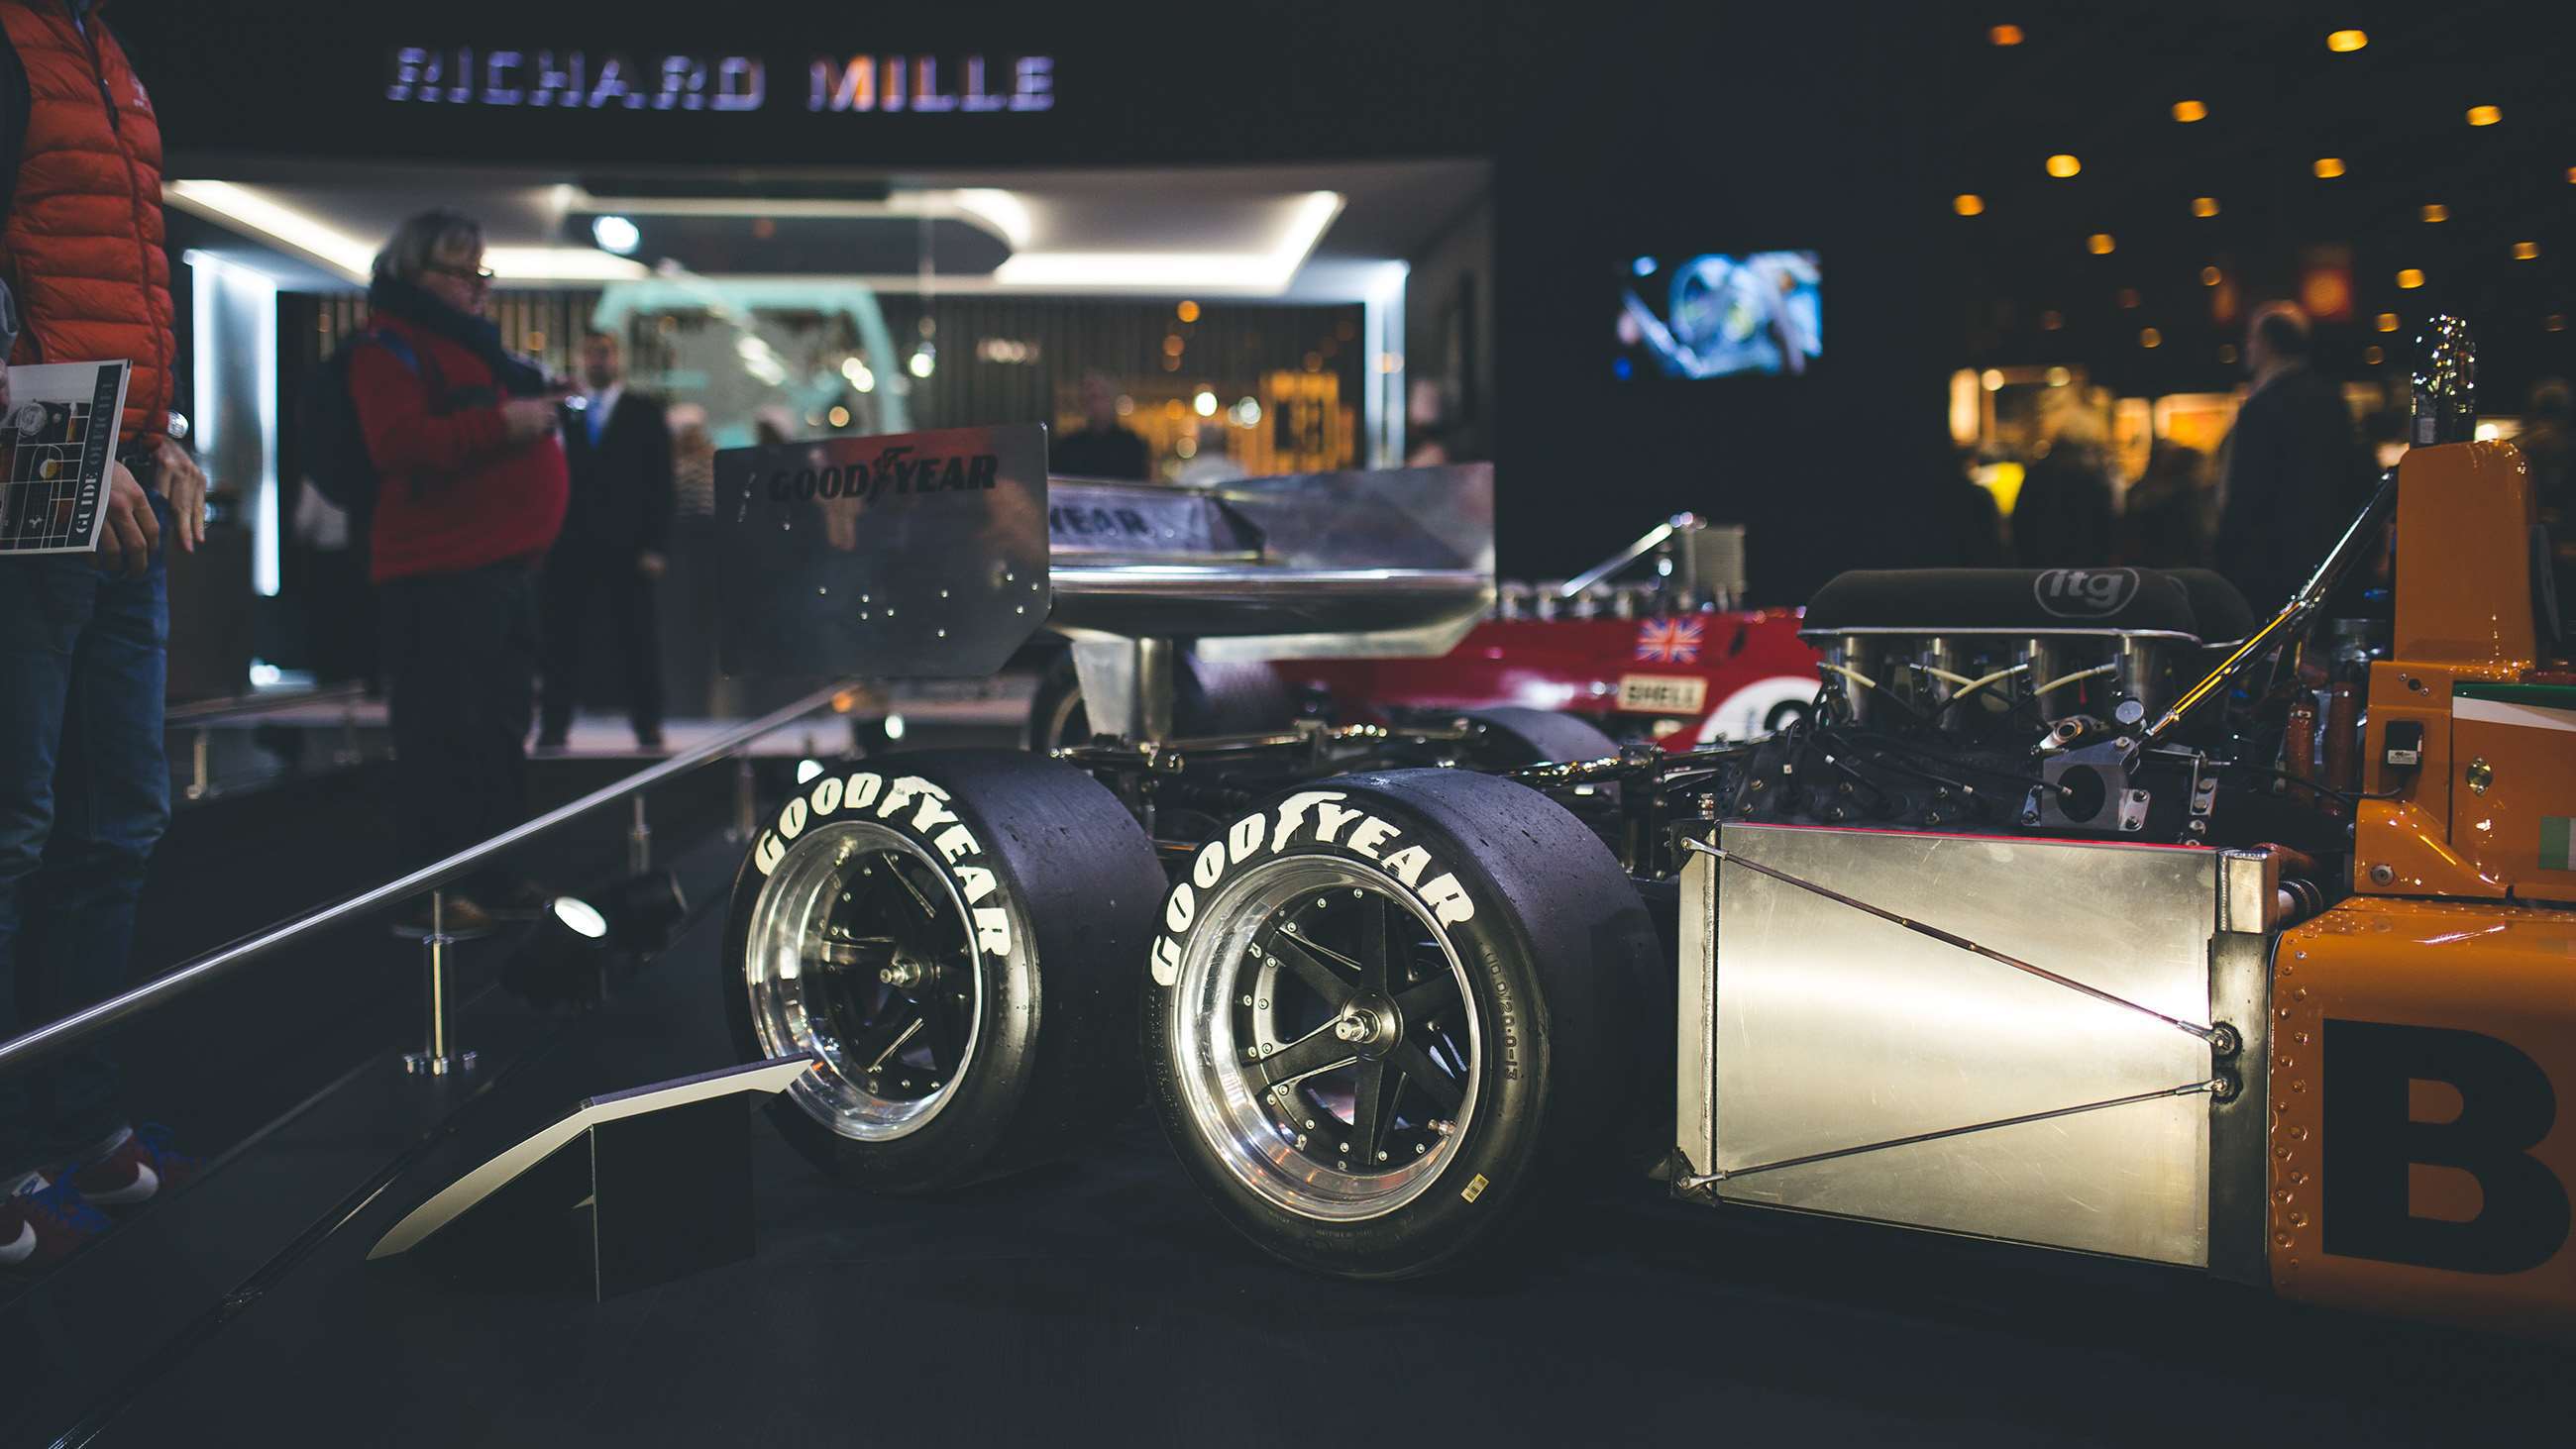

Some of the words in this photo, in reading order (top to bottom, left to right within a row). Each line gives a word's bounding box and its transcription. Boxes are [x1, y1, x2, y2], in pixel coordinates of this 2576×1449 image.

[385, 46, 765, 112] RICHARD
[807, 53, 1056, 114] MILLE
[75, 471, 99, 534] GUIDE
[767, 447, 999, 503] GOODYEAR
[754, 772, 1012, 957] GOODYEAR
[1150, 790, 1475, 986] GOODYEAR
[2322, 1017, 2571, 1276] B
